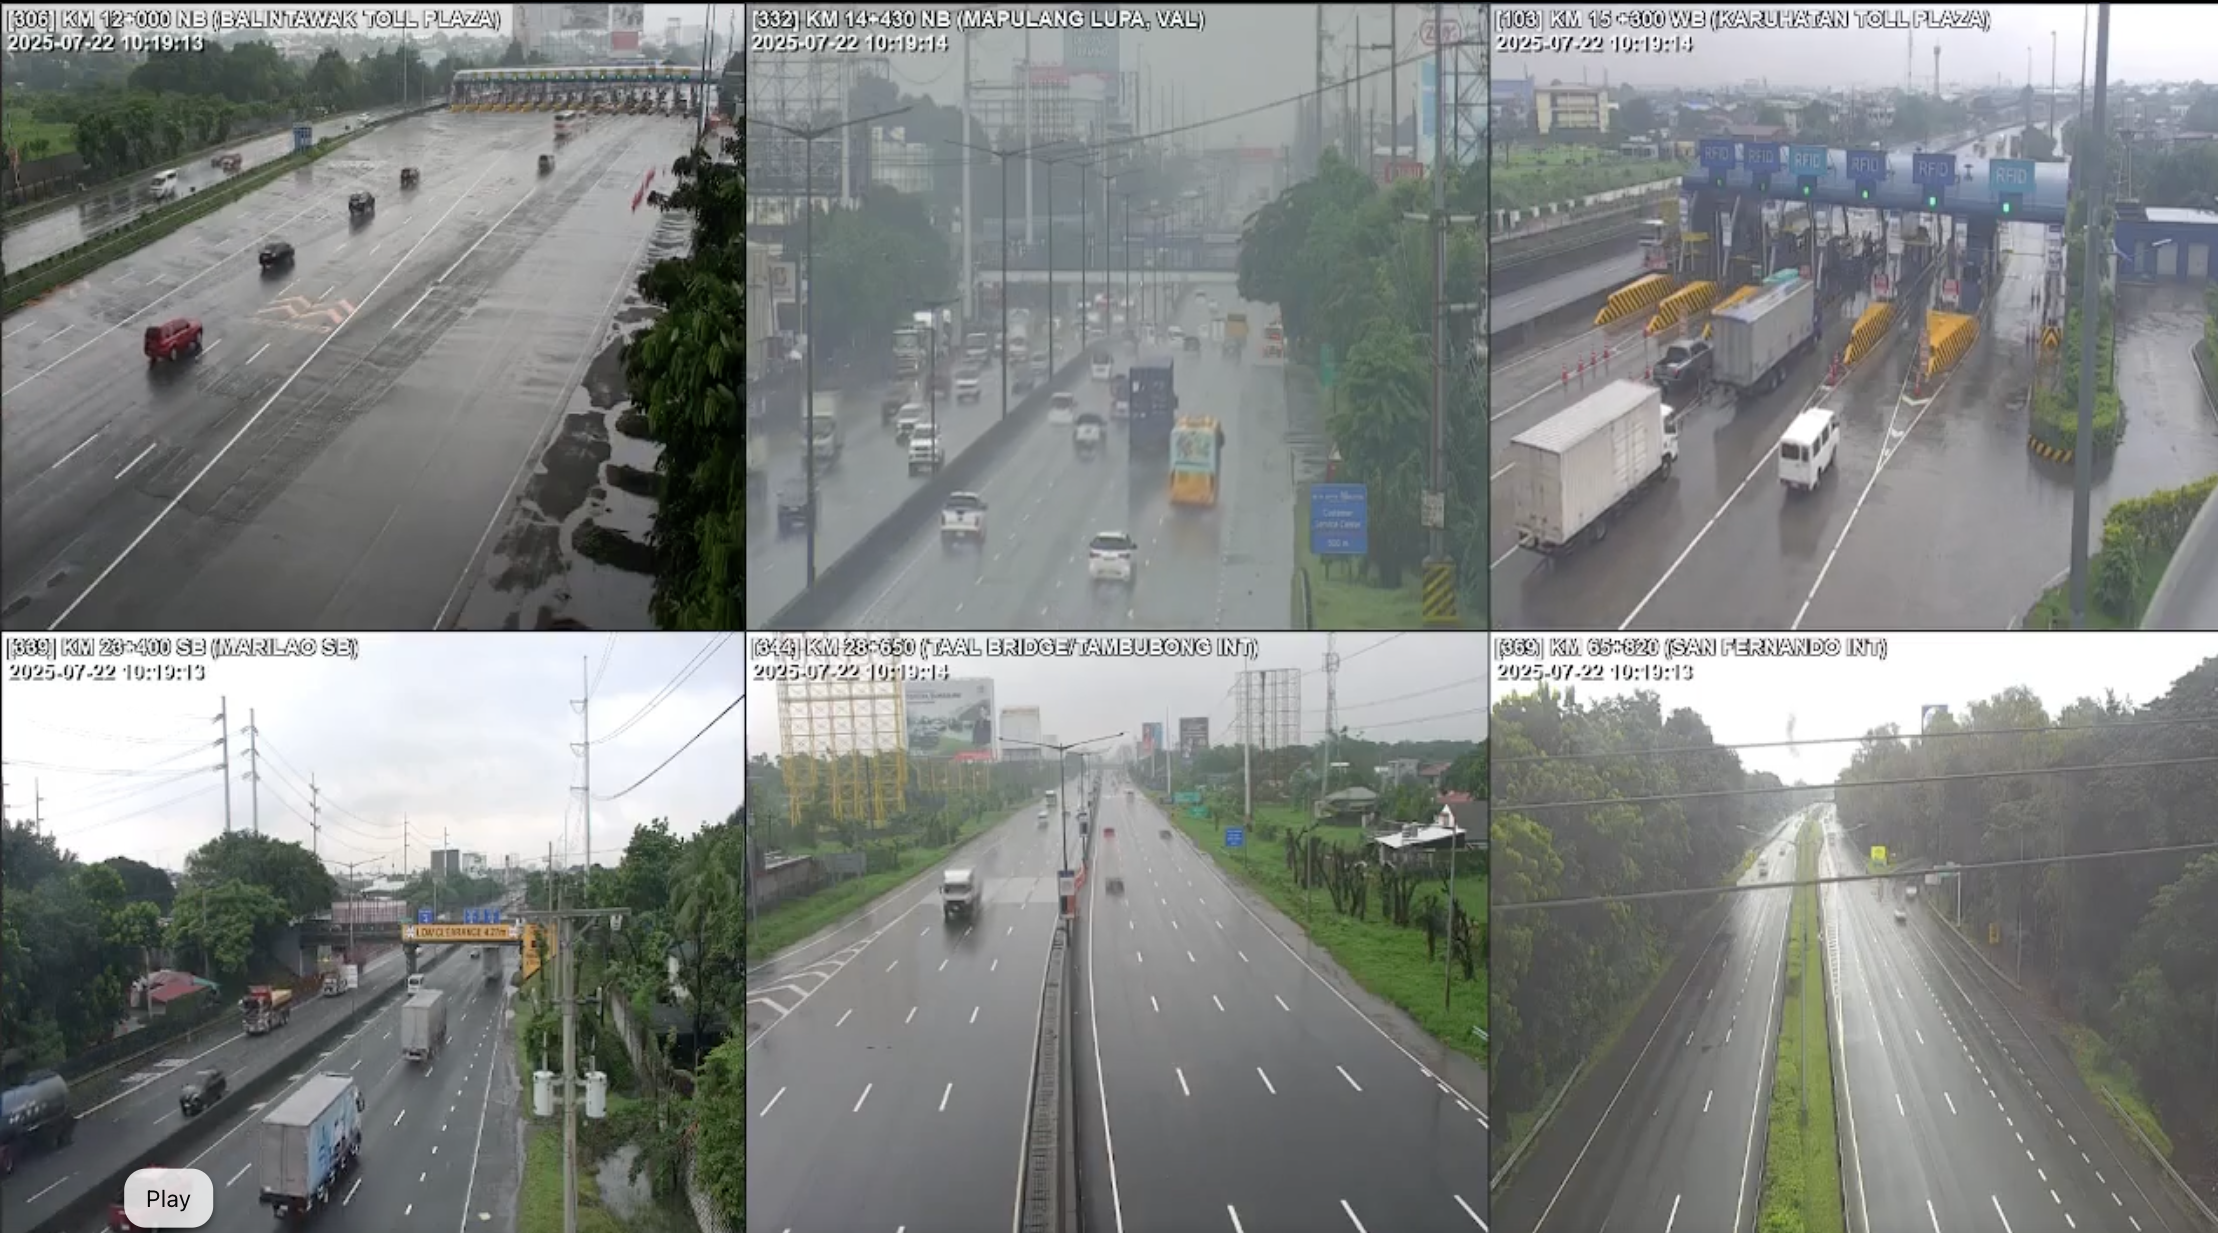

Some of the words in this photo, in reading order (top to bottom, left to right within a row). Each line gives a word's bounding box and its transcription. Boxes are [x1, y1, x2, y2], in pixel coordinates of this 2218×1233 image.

[1704, 146, 1729, 160] RFID
[1795, 153, 1821, 169] RFID
[1852, 157, 1878, 172] RFID
[1919, 161, 1948, 177] RFID
[1996, 168, 2026, 184] RFID
